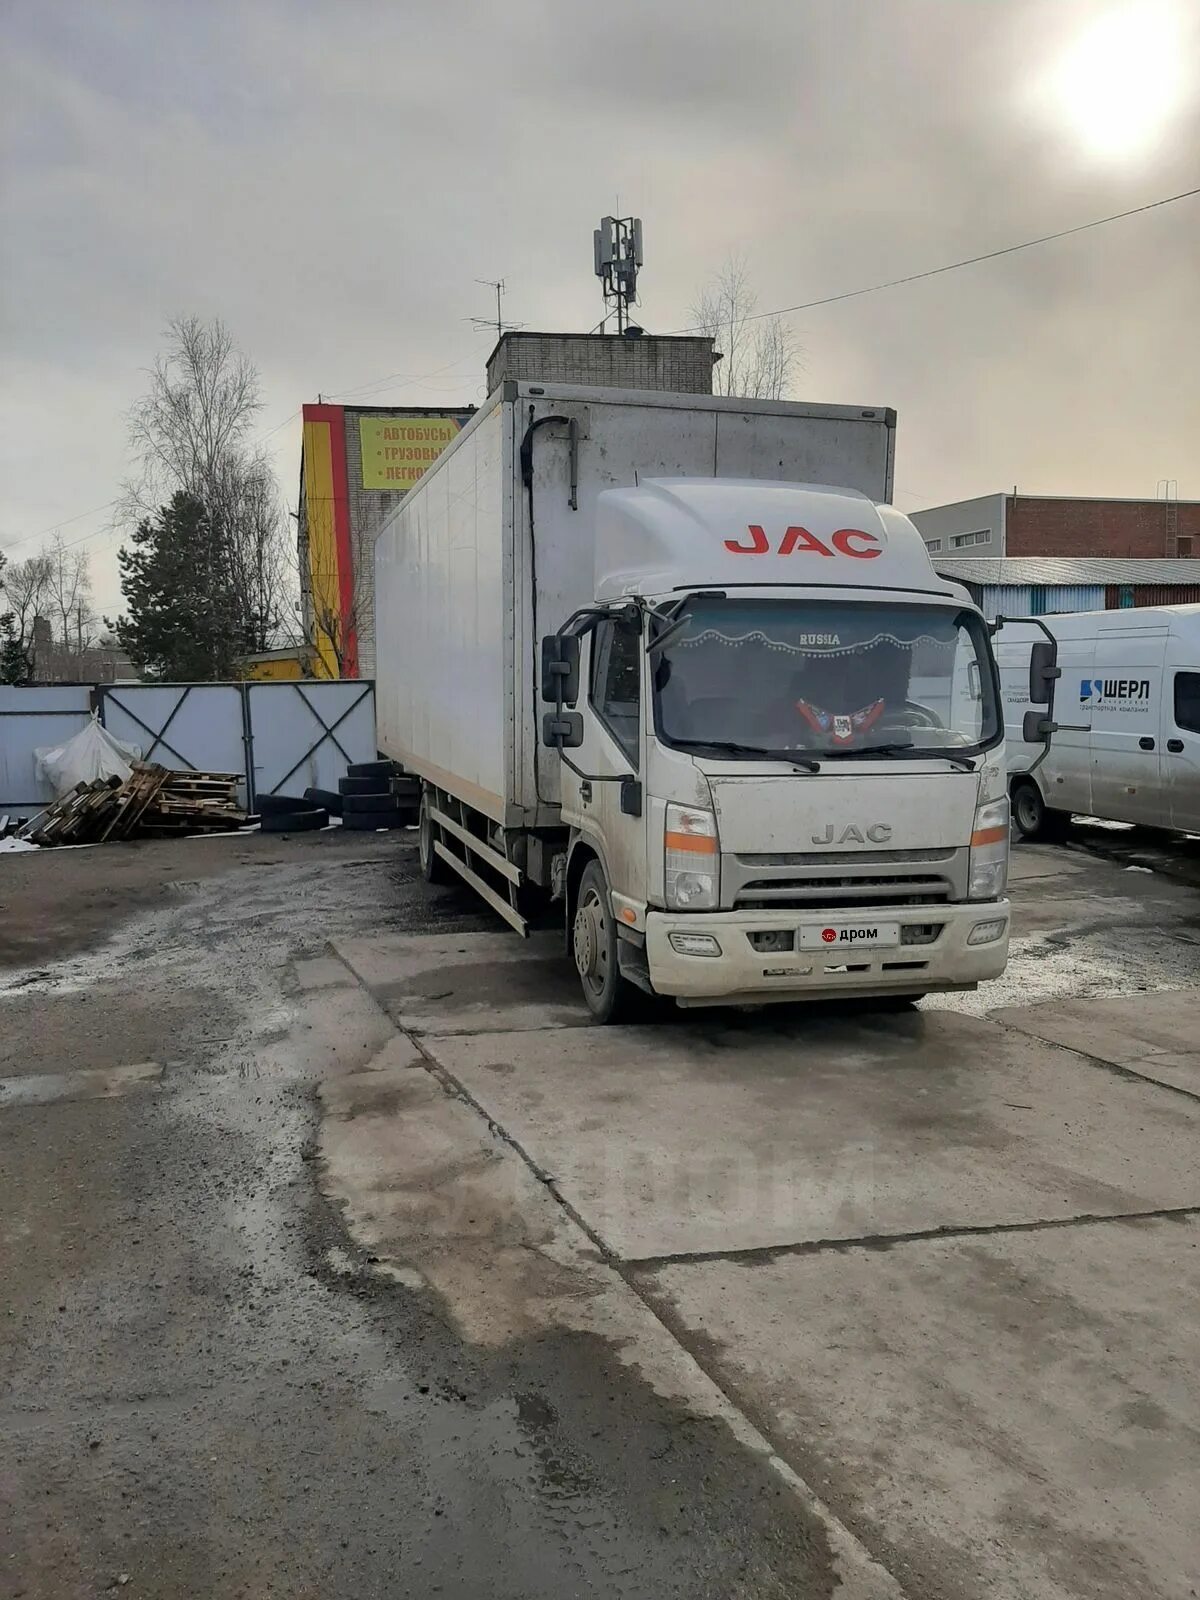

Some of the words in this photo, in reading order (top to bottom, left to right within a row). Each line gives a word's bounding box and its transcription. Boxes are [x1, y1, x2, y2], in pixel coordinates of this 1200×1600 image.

[383, 427, 452, 441] АВТОБУСЫ
[384, 447, 446, 461] ГРУЗОВЫ
[724, 525, 883, 559] JAC
[799, 634, 840, 645] RUSSIA
[1104, 680, 1150, 699] ШЕРЛ
[811, 823, 892, 845] JAC
